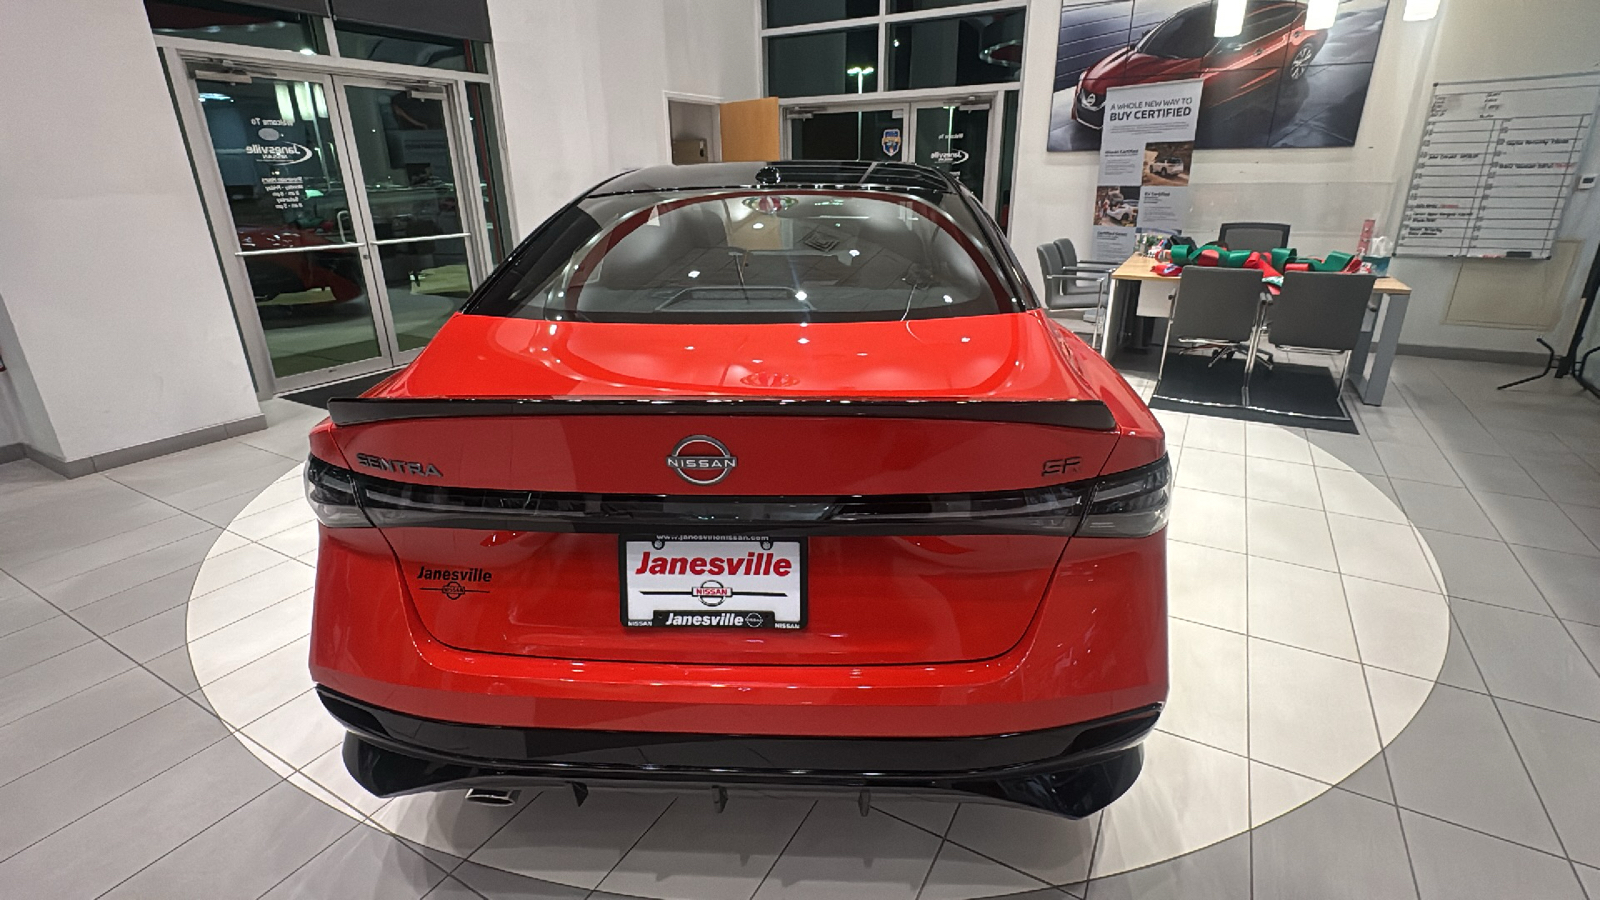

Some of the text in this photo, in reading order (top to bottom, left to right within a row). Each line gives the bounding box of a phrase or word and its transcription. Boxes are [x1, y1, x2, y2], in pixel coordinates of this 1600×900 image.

[1117, 102, 1142, 110] WHOLE
[1145, 100, 1162, 108] NEW
[1163, 98, 1180, 106] WAY
[1110, 107, 1191, 121] BUY CERTIFIED
[357, 453, 443, 478] SENTRA
[668, 459, 735, 467] NISSAN
[636, 552, 792, 576] Janesville
[417, 567, 492, 582] Janesville
[666, 613, 743, 626] Janesville
